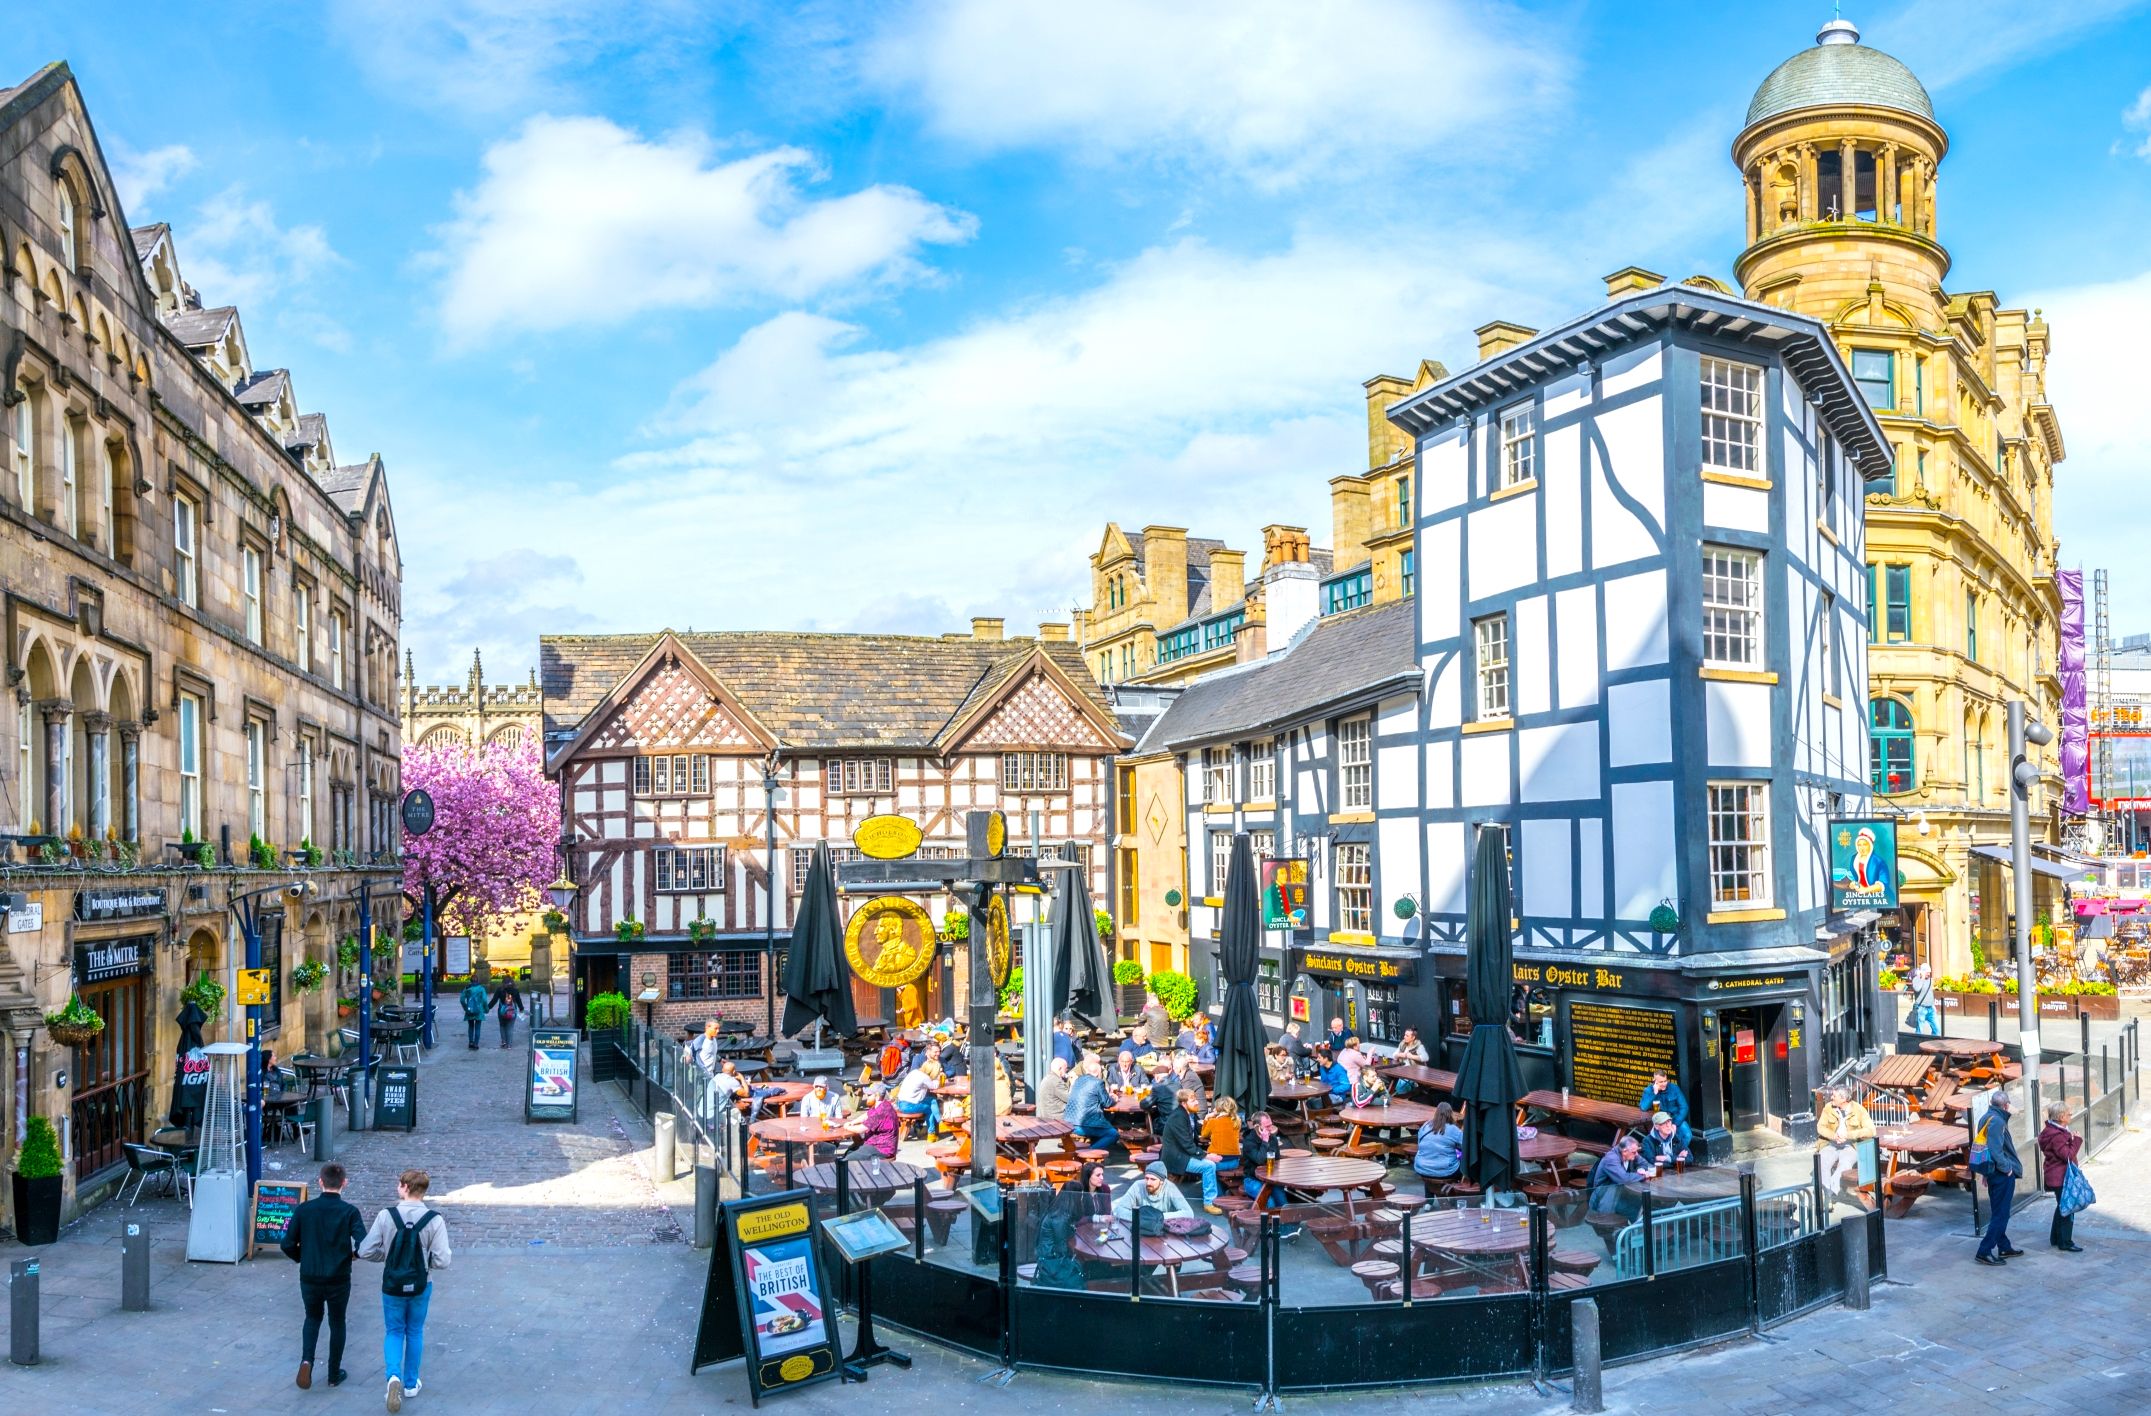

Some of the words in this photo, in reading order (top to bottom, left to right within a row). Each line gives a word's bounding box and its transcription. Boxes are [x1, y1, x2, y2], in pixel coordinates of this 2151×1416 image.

[18, 918, 34, 930] GATES
[88, 952, 105, 968] THE
[114, 946, 138, 966] MITRE
[1305, 954, 1342, 970] Sinclairs
[1346, 958, 1376, 976] Oyster
[1378, 960, 1399, 977] Bar
[88, 966, 138, 981] MANCHESTER
[1512, 964, 1540, 981] lairs
[1546, 966, 1588, 986] Oyster
[1595, 968, 1622, 989] Bar
[1725, 979, 1763, 988] CATHEDRAL
[2042, 1002, 2068, 1011] banyan
[756, 1215, 772, 1223] THE
[774, 1211, 790, 1220] OLD
[744, 1217, 805, 1236] WELLINGTON
[758, 1270, 772, 1282] THE
[775, 1266, 792, 1278] BEST
[796, 1264, 804, 1274] OF
[760, 1274, 807, 1296] BRITISH
